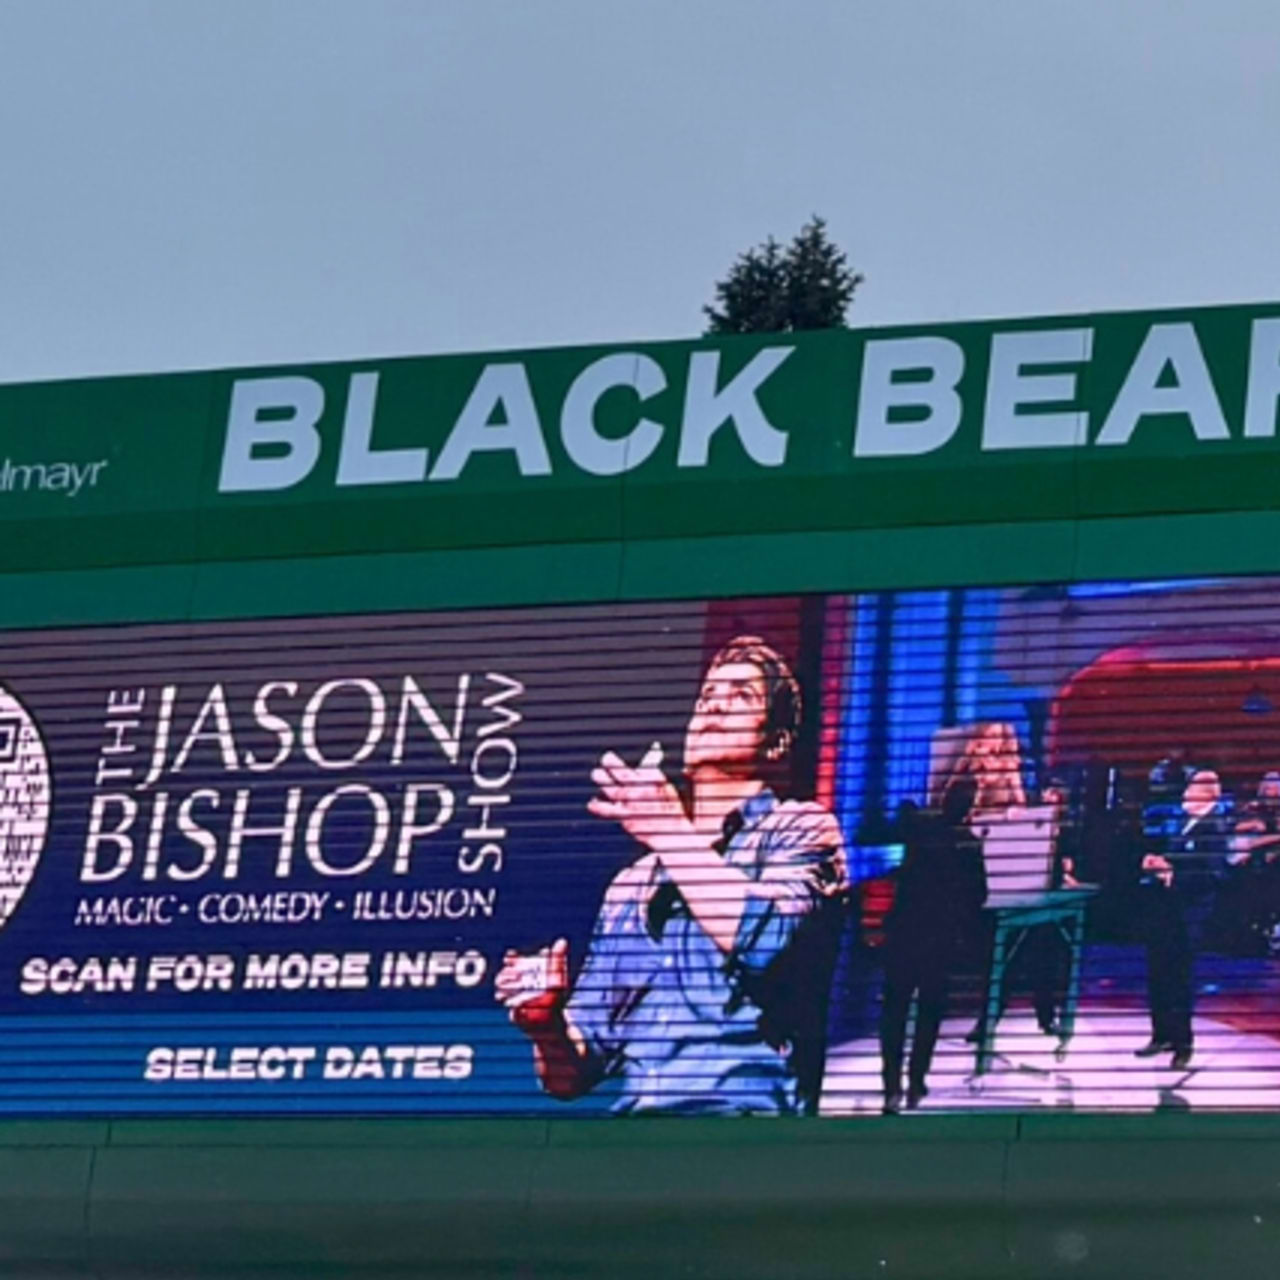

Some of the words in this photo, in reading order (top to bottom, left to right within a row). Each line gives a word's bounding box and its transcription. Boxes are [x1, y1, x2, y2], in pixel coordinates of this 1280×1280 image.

[218, 345, 797, 492] BLACK
[0, 458, 109, 497] lmayr
[95, 688, 145, 784] THE
[134, 673, 471, 790] JASON
[458, 673, 525, 873] SHOW
[79, 783, 455, 881] BISHOP
[75, 894, 176, 926] MAGIC
[199, 892, 330, 923] COMEDY
[353, 888, 496, 921] ILLUSION
[20, 956, 136, 994] SCAN
[146, 955, 234, 991] FOR
[243, 952, 369, 990] MORE
[380, 950, 487, 988] INFO
[143, 1047, 316, 1081] SELECT
[323, 1044, 474, 1079] DATES
